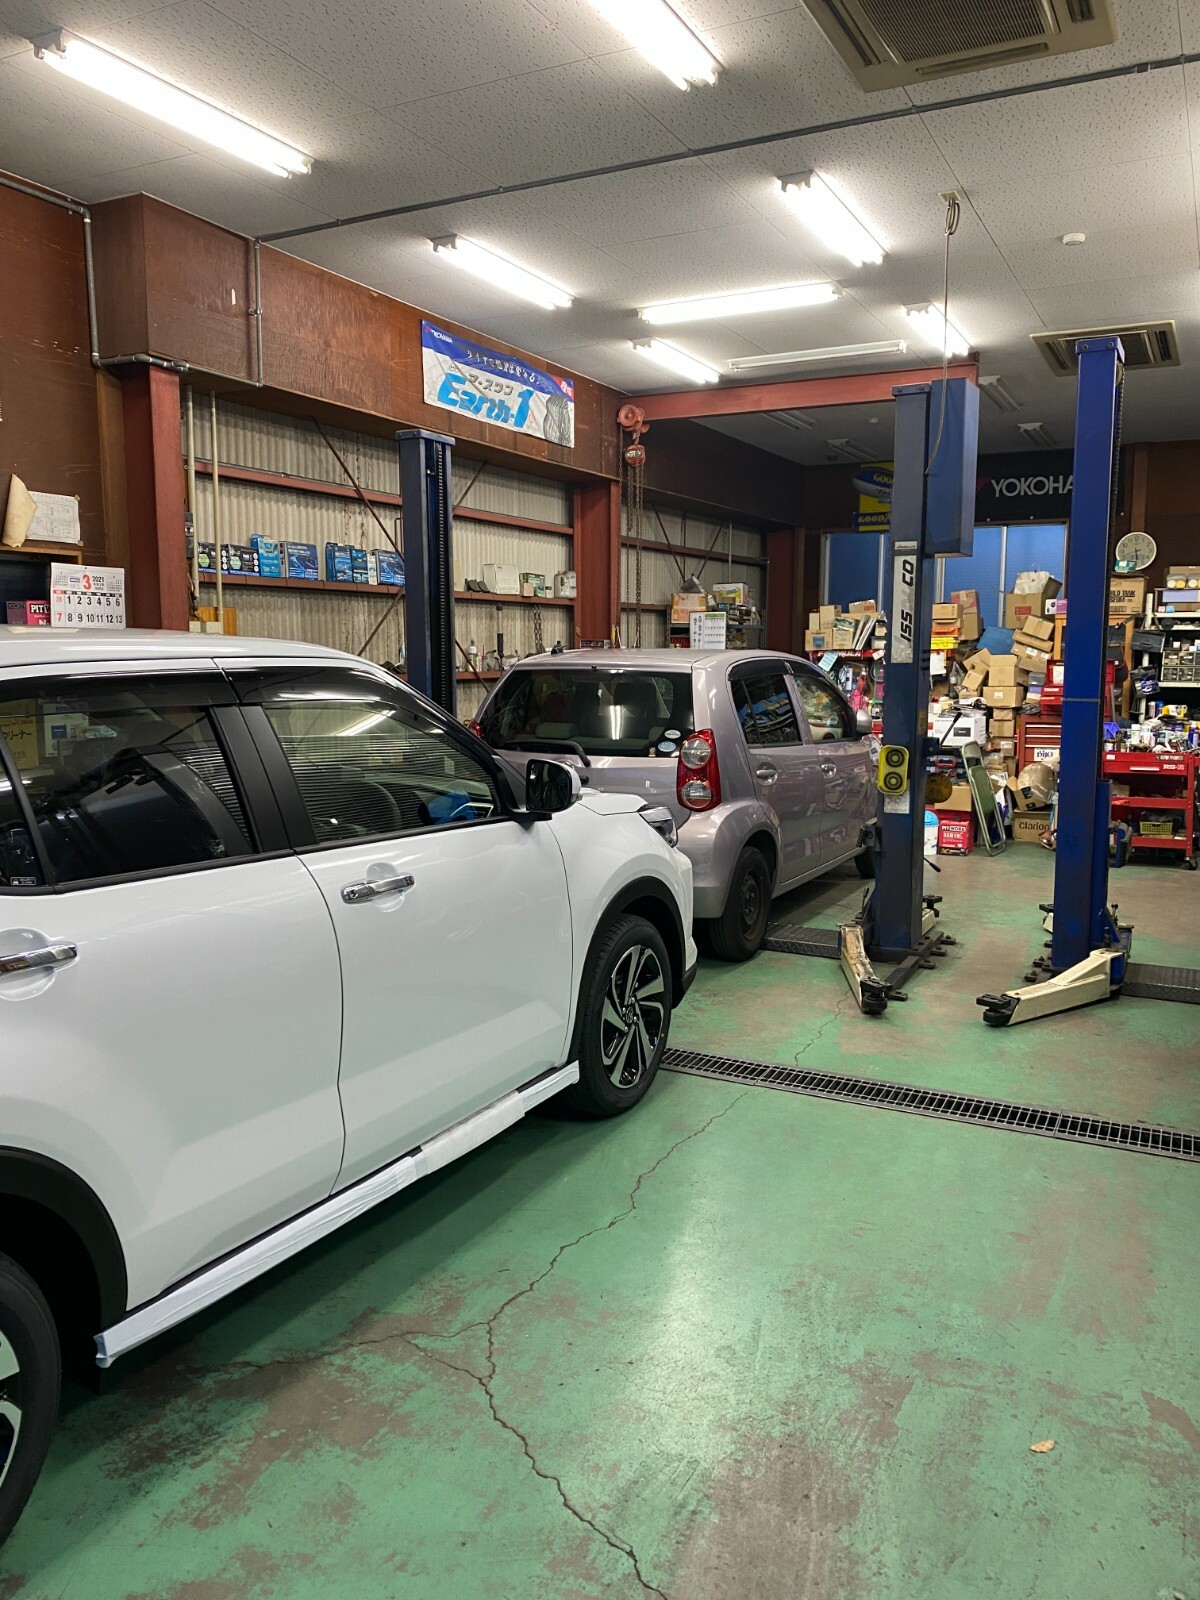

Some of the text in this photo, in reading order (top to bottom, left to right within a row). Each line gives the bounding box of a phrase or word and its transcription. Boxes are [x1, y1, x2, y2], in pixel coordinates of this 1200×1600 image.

[82, 574, 92, 590] 3
[77, 596, 82, 604] 2
[86, 596, 92, 605] 3
[96, 597, 102, 605] 4
[105, 597, 111, 606] 5
[115, 598, 121, 606] 6
[57, 612, 123, 623] 7 8 9 10 11 12 13
[1018, 821, 1050, 831] Clarion
